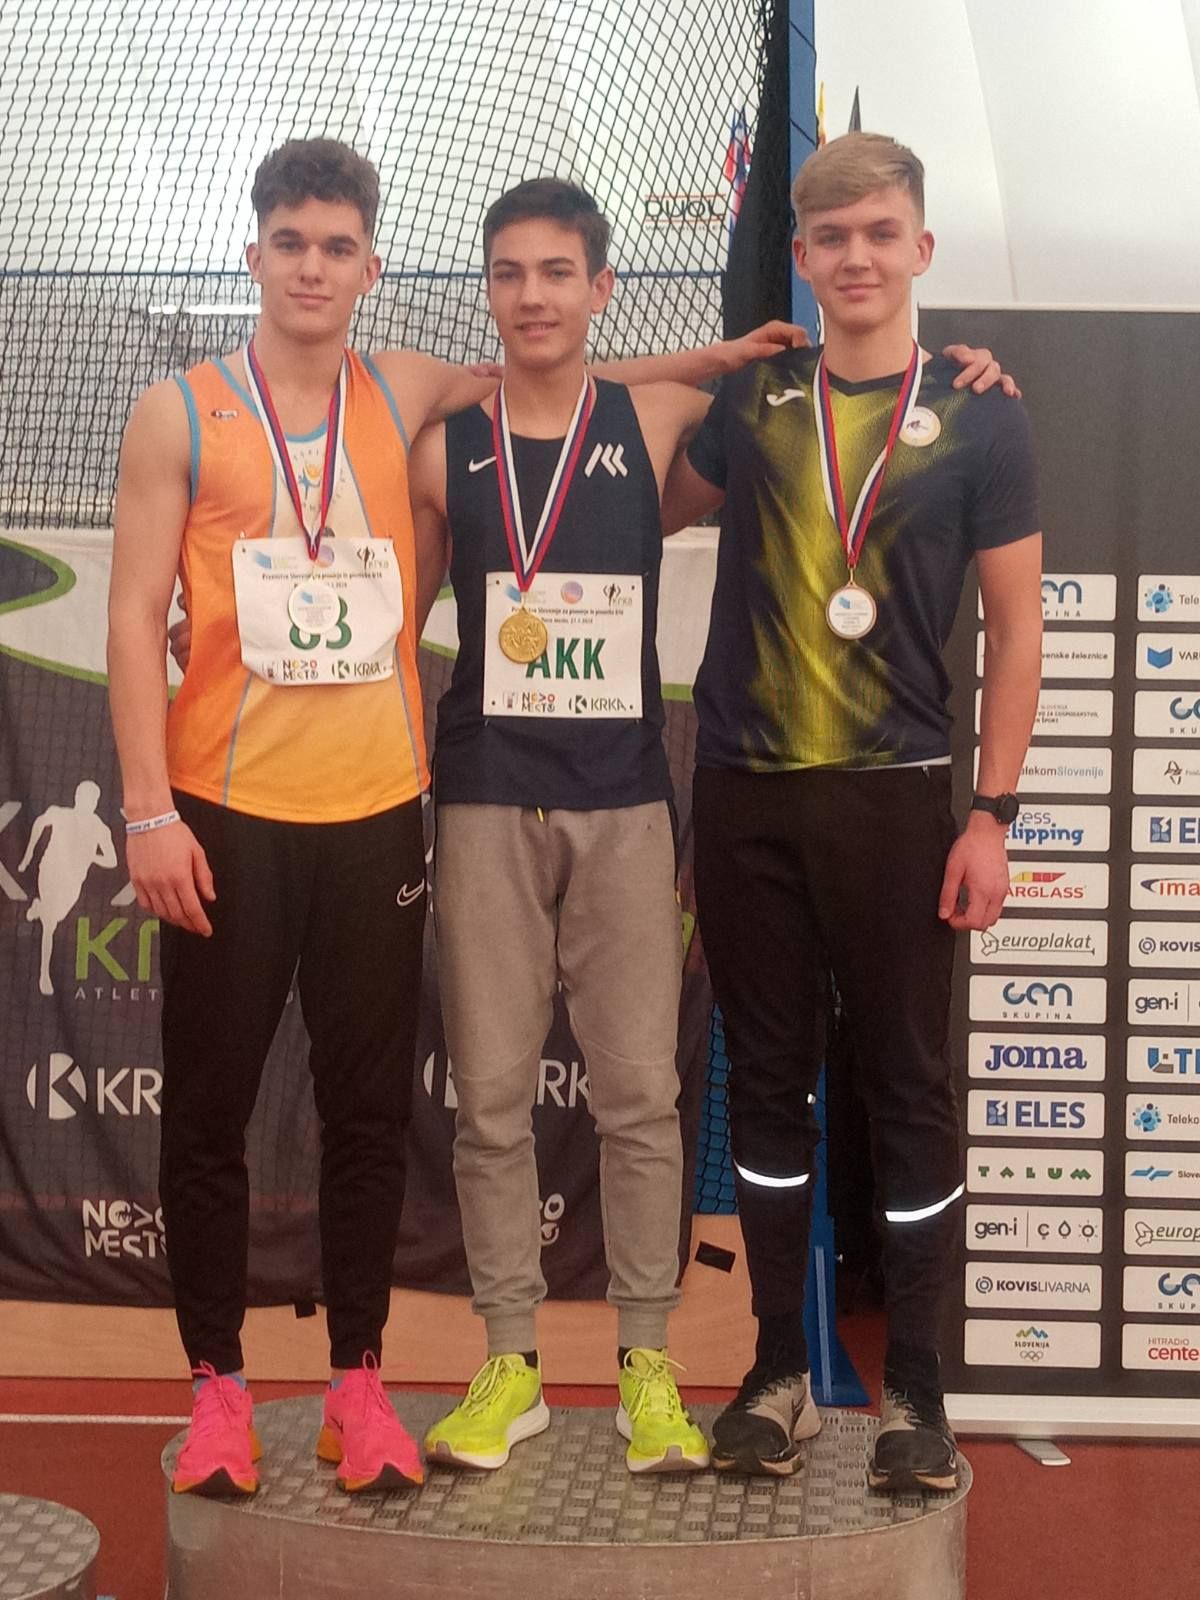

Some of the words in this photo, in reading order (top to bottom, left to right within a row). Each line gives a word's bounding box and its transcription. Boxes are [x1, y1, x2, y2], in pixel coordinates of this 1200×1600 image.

[591, 697, 627, 712] KRKA
[1019, 812, 1052, 825] ess
[1005, 821, 1084, 846] lipping
[1001, 933, 1092, 950] europlakat
[1002, 1011, 1073, 1020] SKUPINA
[1015, 1100, 1086, 1129] ELES
[978, 1165, 1092, 1181] TALUM
[84, 1229, 167, 1258] MEST
[1014, 1340, 1050, 1349] SLOVENIJA
[1148, 1337, 1190, 1346] HITRADIO
